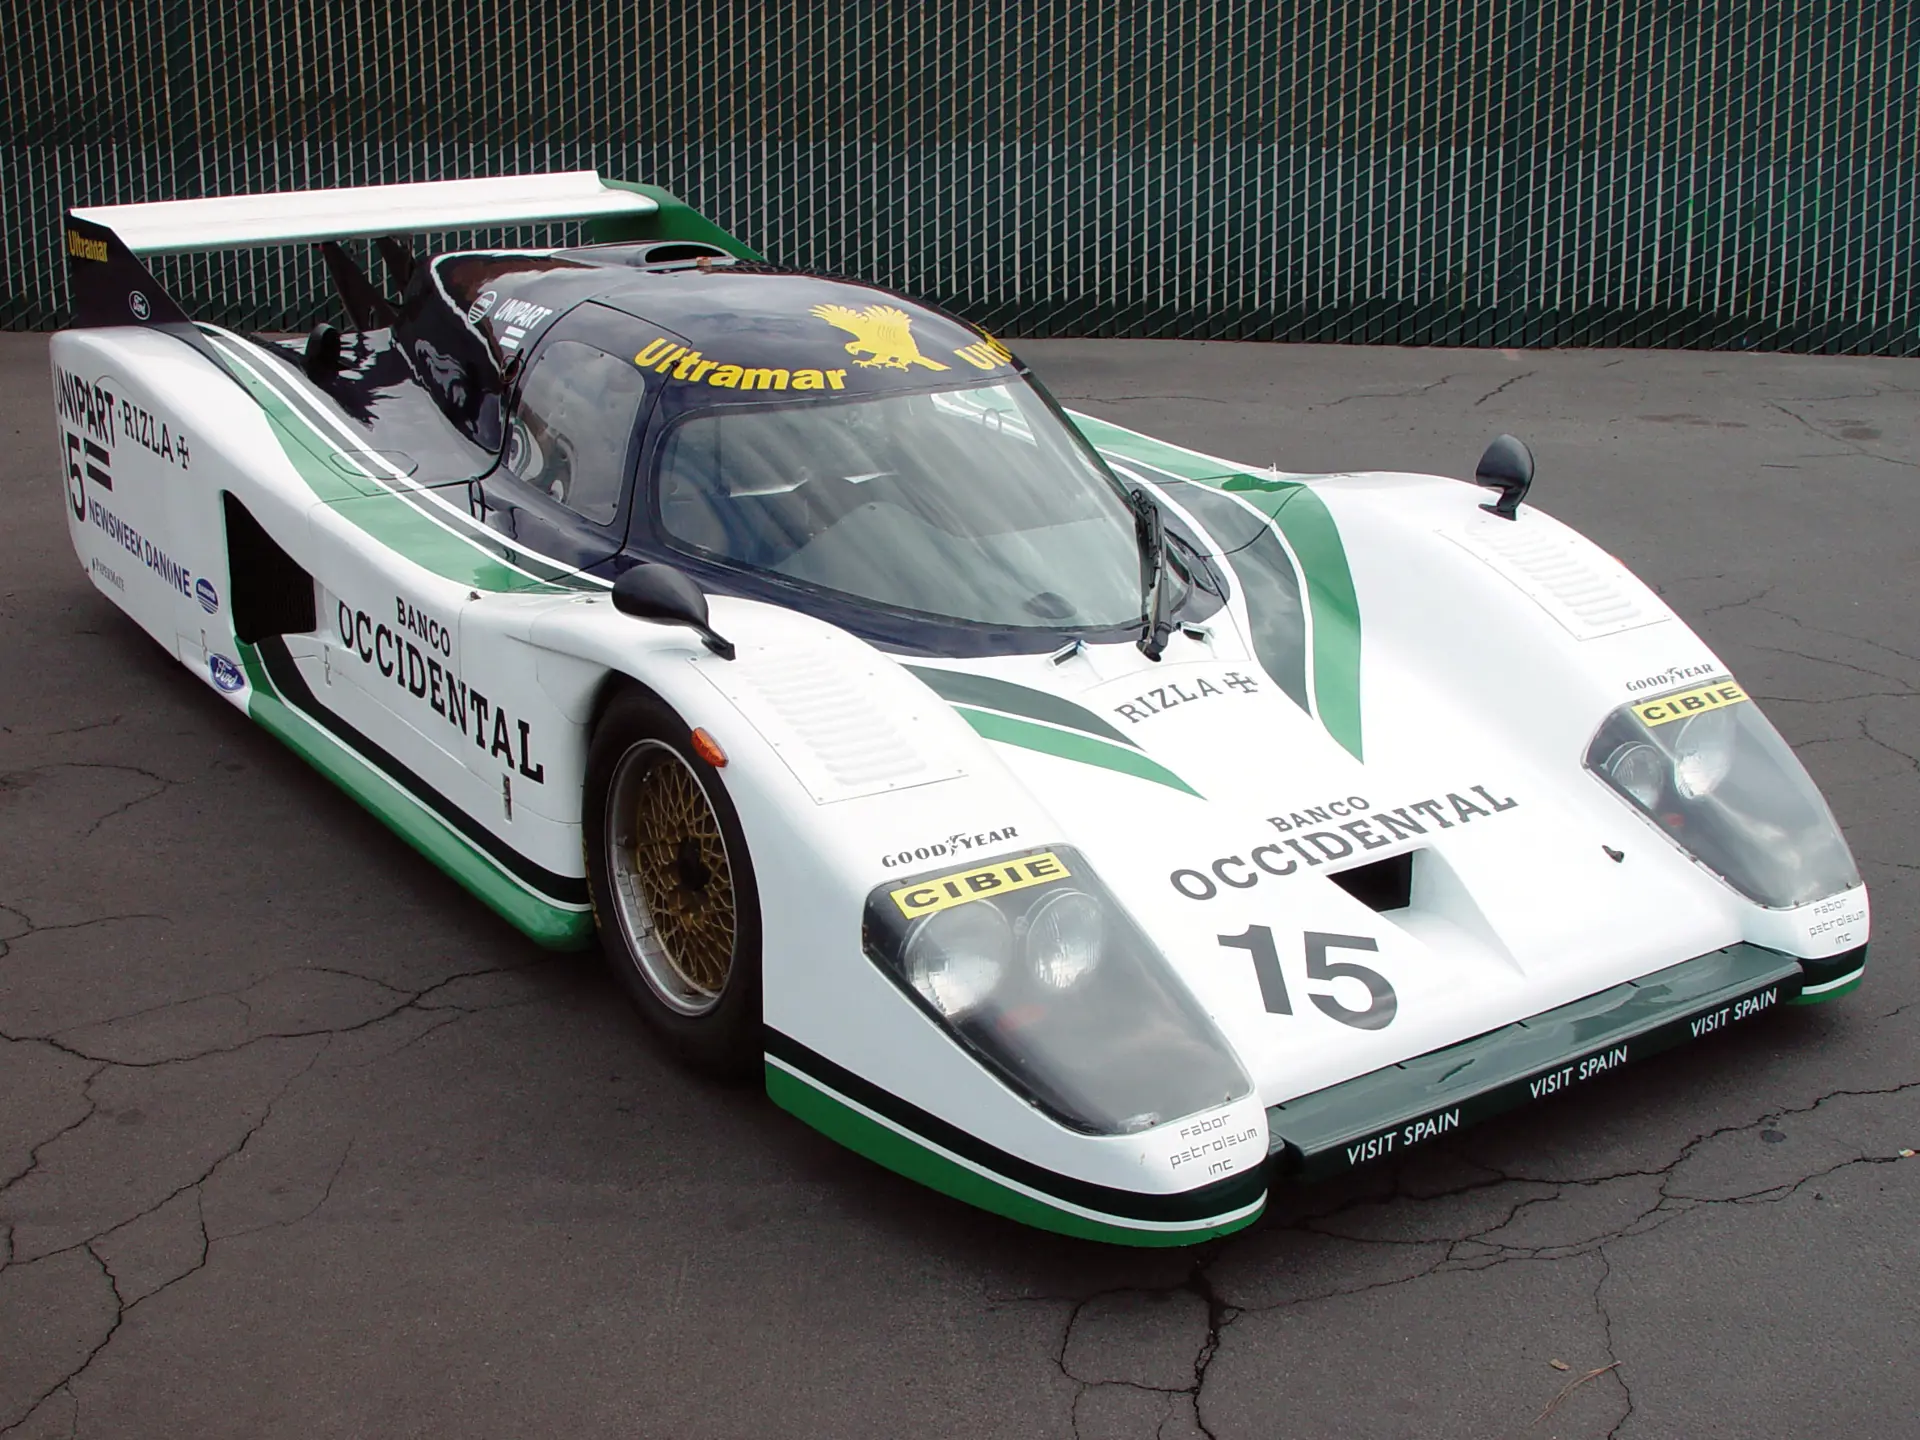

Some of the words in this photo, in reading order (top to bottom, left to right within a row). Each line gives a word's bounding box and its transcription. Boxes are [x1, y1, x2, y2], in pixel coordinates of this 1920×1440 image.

[67, 229, 108, 264] Ultramar
[494, 298, 553, 330] UNIPART
[633, 337, 847, 391] Ultramar
[122, 399, 175, 464] RIZLA
[88, 495, 144, 563] NEWSWEEK
[145, 539, 193, 599] DANONE
[396, 596, 450, 657] BANCO
[338, 600, 545, 784] OCCIDENTAL
[1114, 678, 1223, 723] RIZLA
[1643, 686, 1742, 720] CIBIE
[1266, 796, 1370, 832] BANCO
[881, 826, 1019, 868] GOODYEAR
[1170, 785, 1519, 900] OCCIDENTAL
[904, 858, 1060, 908] CIBIE
[1217, 924, 1398, 1031] 15
[1690, 1008, 1729, 1038] VISIT
[1734, 987, 1778, 1021] SPAIN
[1530, 1067, 1573, 1099] VISIT
[1578, 1045, 1628, 1080] SPAIN
[1347, 1132, 1397, 1166] VISIT
[1403, 1109, 1460, 1146] SPAIN
